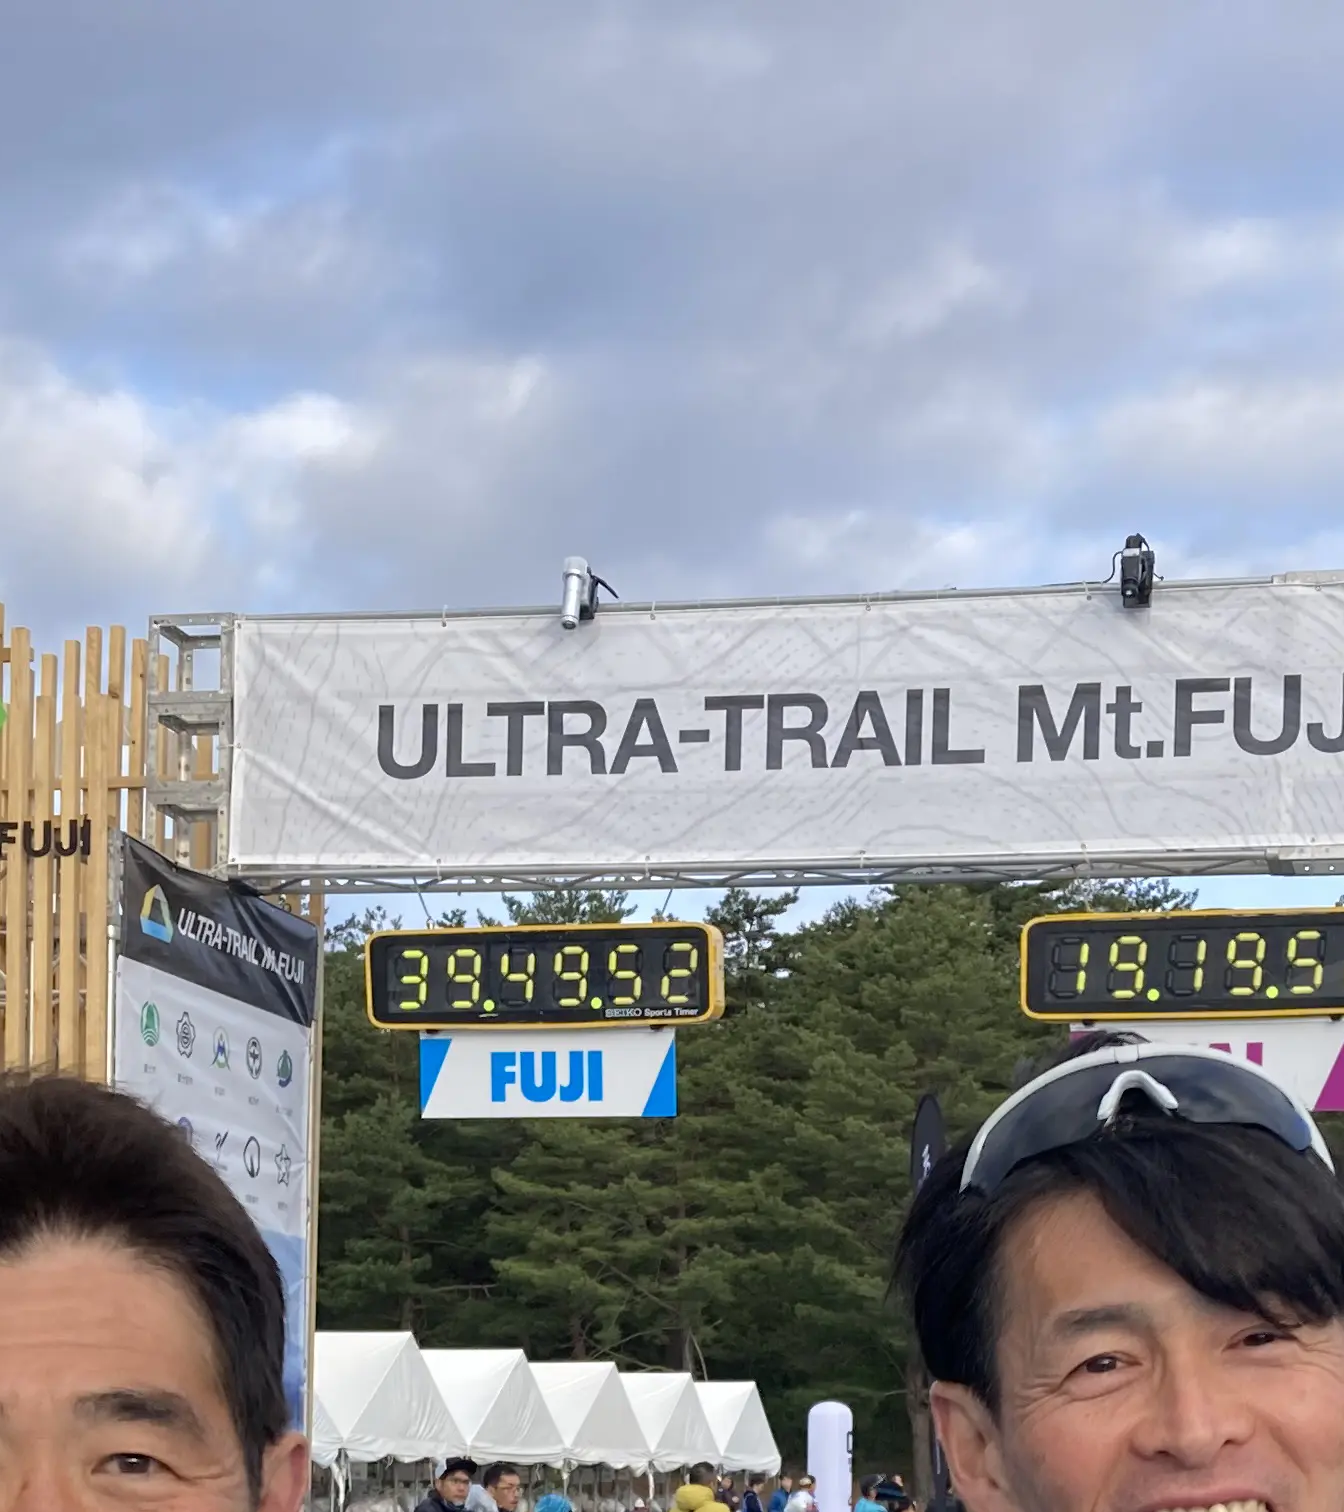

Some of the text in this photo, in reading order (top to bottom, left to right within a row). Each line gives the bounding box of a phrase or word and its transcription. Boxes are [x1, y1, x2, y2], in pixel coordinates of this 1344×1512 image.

[376, 686, 985, 780] ULTRA-TRAIL
[177, 908, 258, 965] ULTRA-TRAIL
[605, 1007, 698, 1018] SEIKO Sports Timer
[491, 1050, 603, 1102] FUJI
